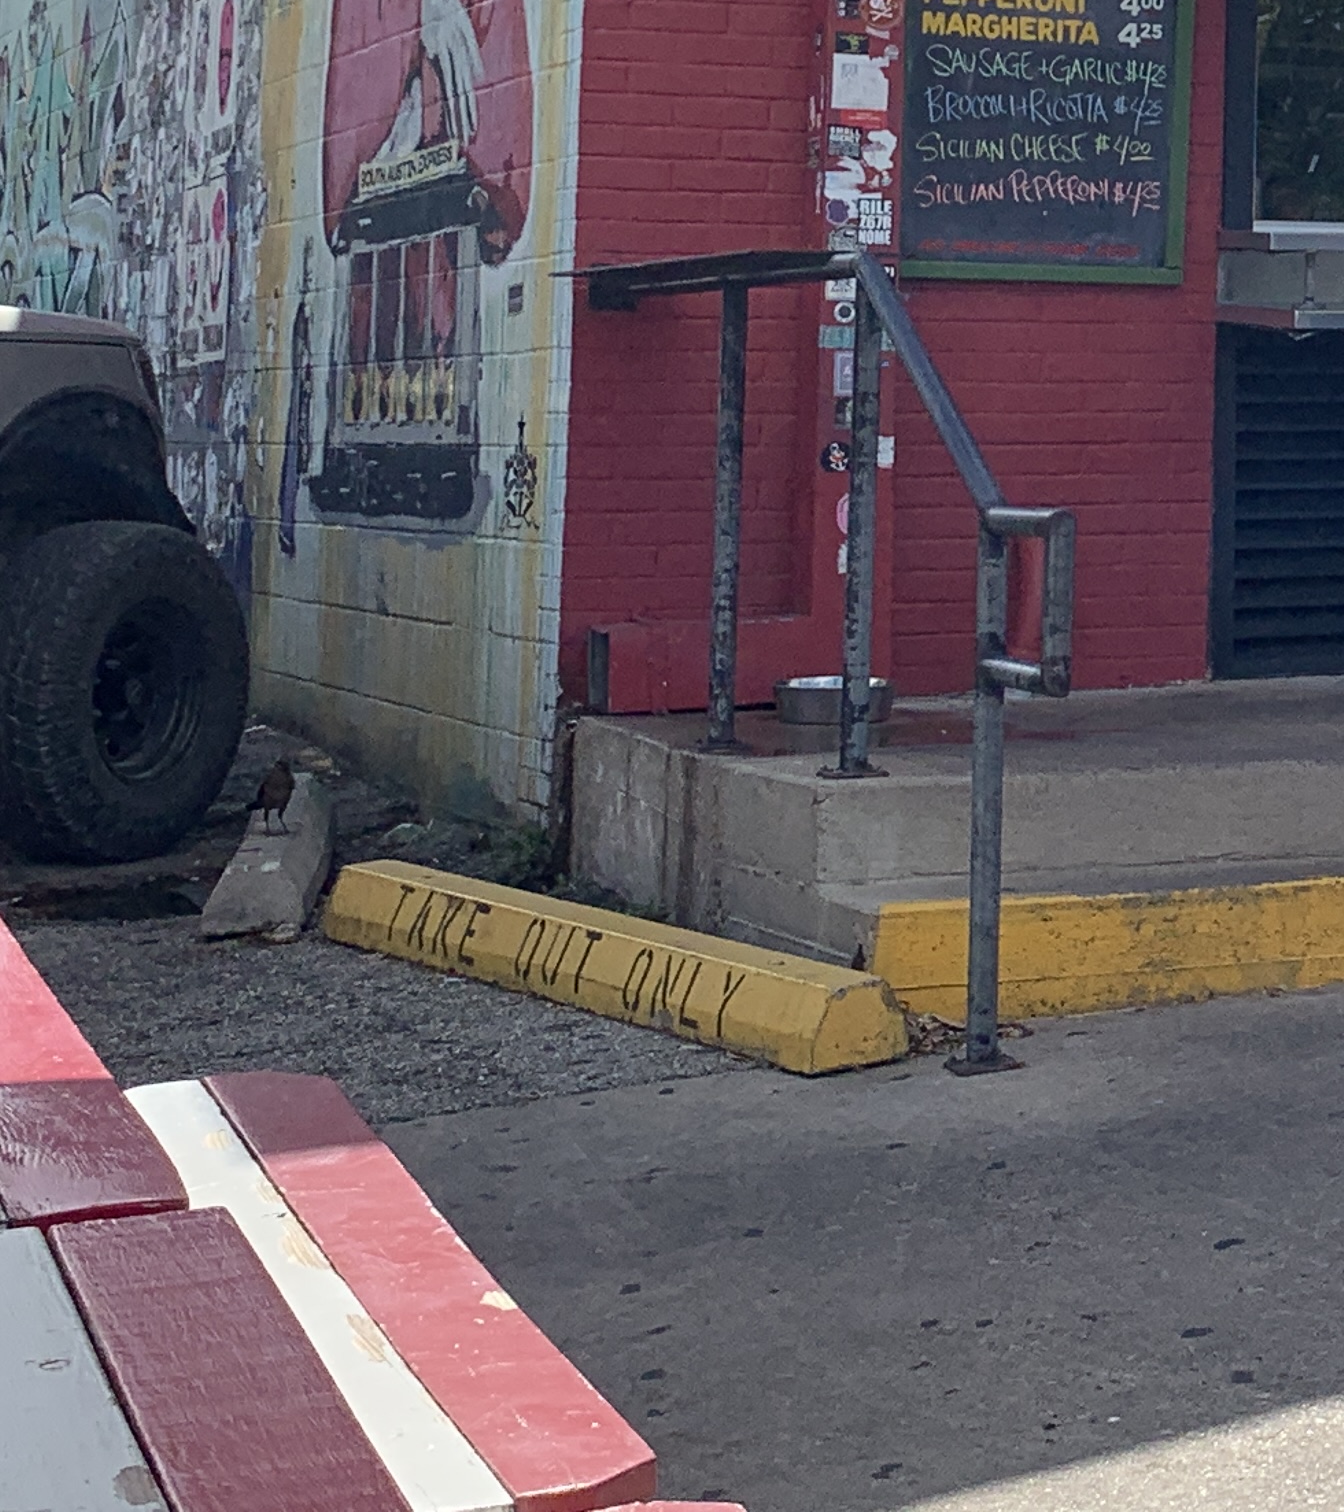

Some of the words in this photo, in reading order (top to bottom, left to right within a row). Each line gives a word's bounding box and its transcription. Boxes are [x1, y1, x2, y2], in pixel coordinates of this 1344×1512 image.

[921, 10, 1099, 46] MARGHERITA
[926, 44, 1034, 77] SAUSAGE
[915, 131, 1005, 163] SICILIAN
[1010, 133, 1089, 163] CHEESE
[915, 175, 1005, 208] SICILIAN
[1008, 168, 1110, 205] PEPPERONI
[386, 883, 491, 967] TAKE
[513, 917, 603, 995] OUT
[622, 948, 746, 1039] ONLY
